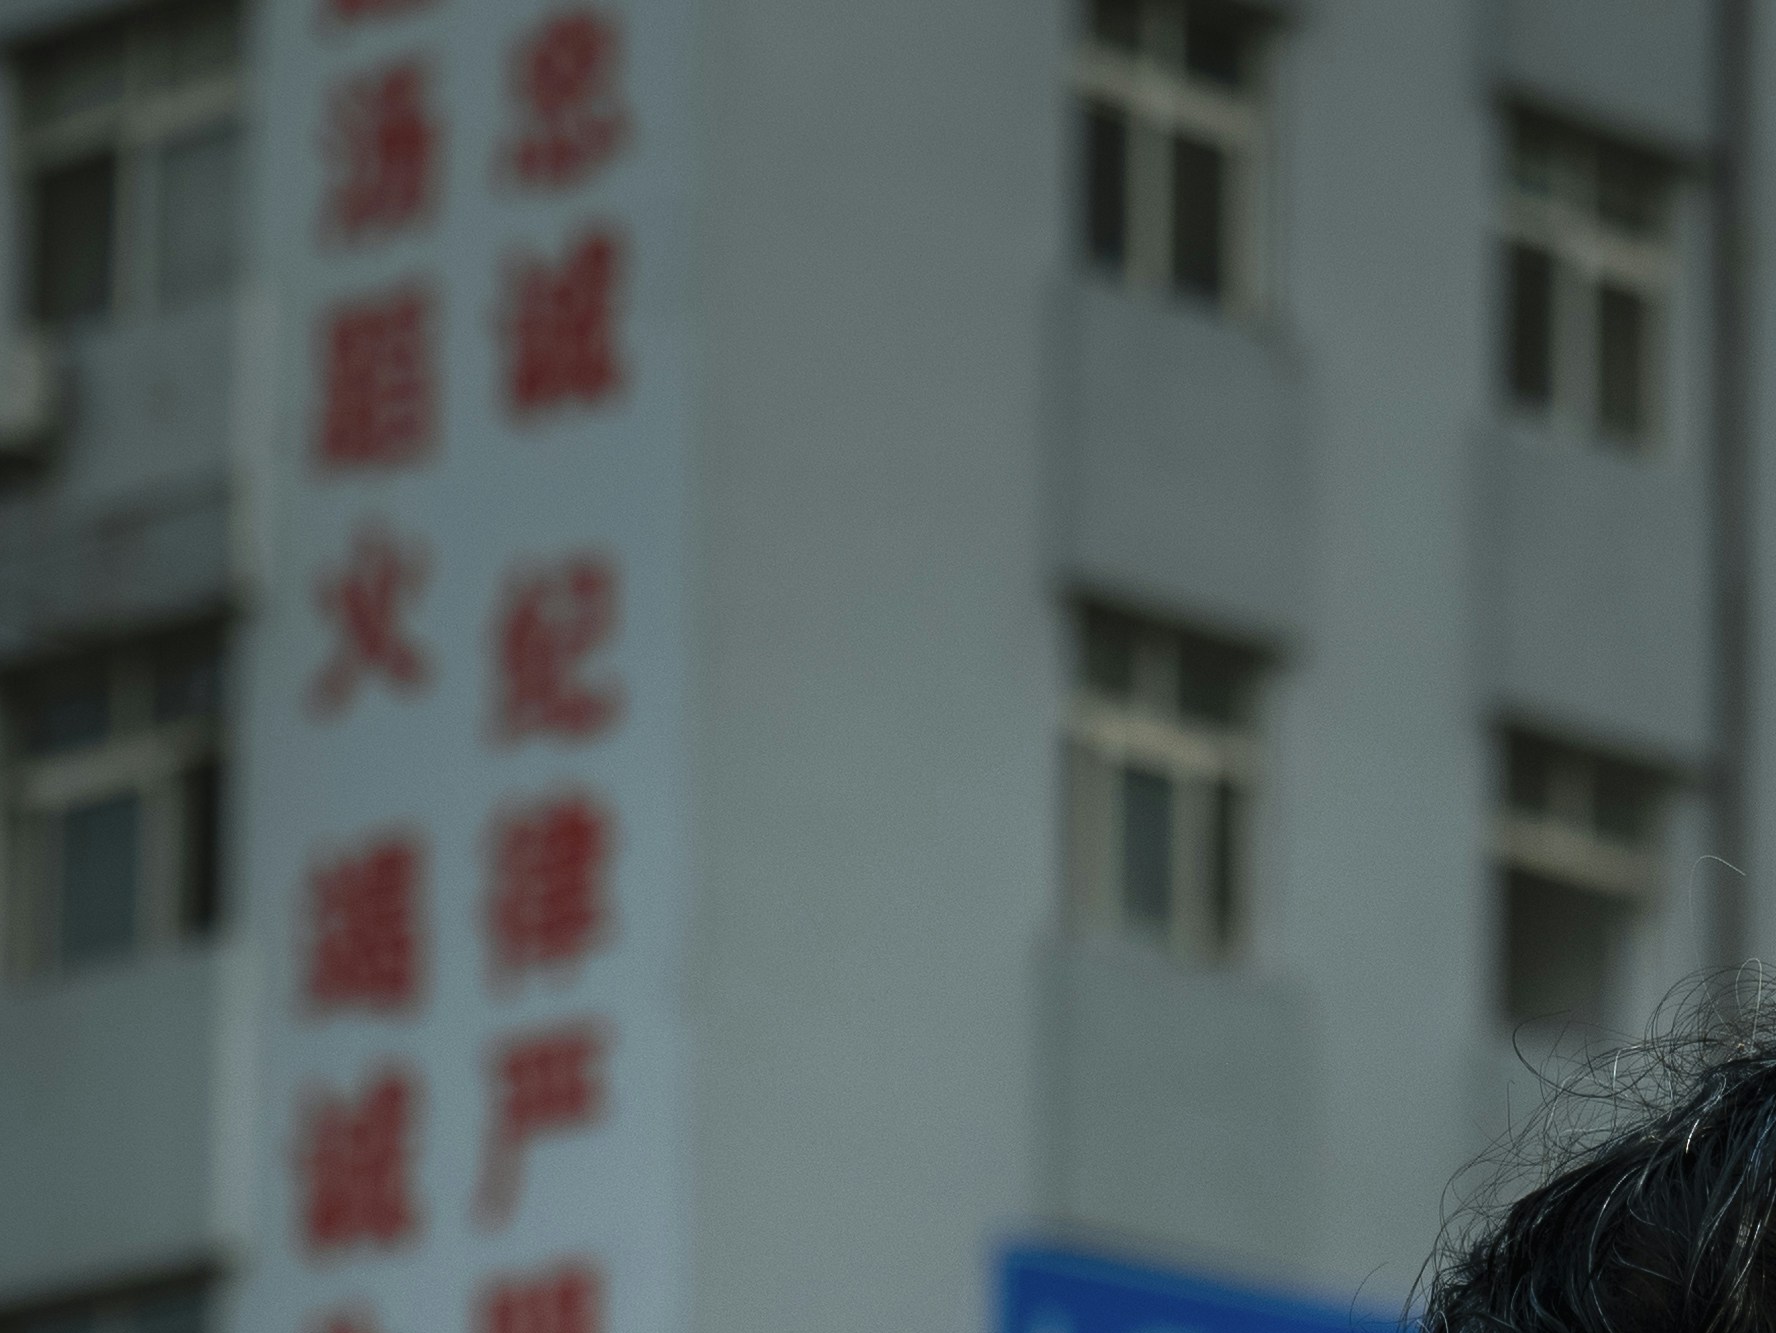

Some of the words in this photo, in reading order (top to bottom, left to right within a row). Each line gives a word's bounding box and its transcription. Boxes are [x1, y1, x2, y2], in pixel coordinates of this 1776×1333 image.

[312, 0, 442, 706] 汤蹈火
[496, 7, 628, 421] 忠诚
